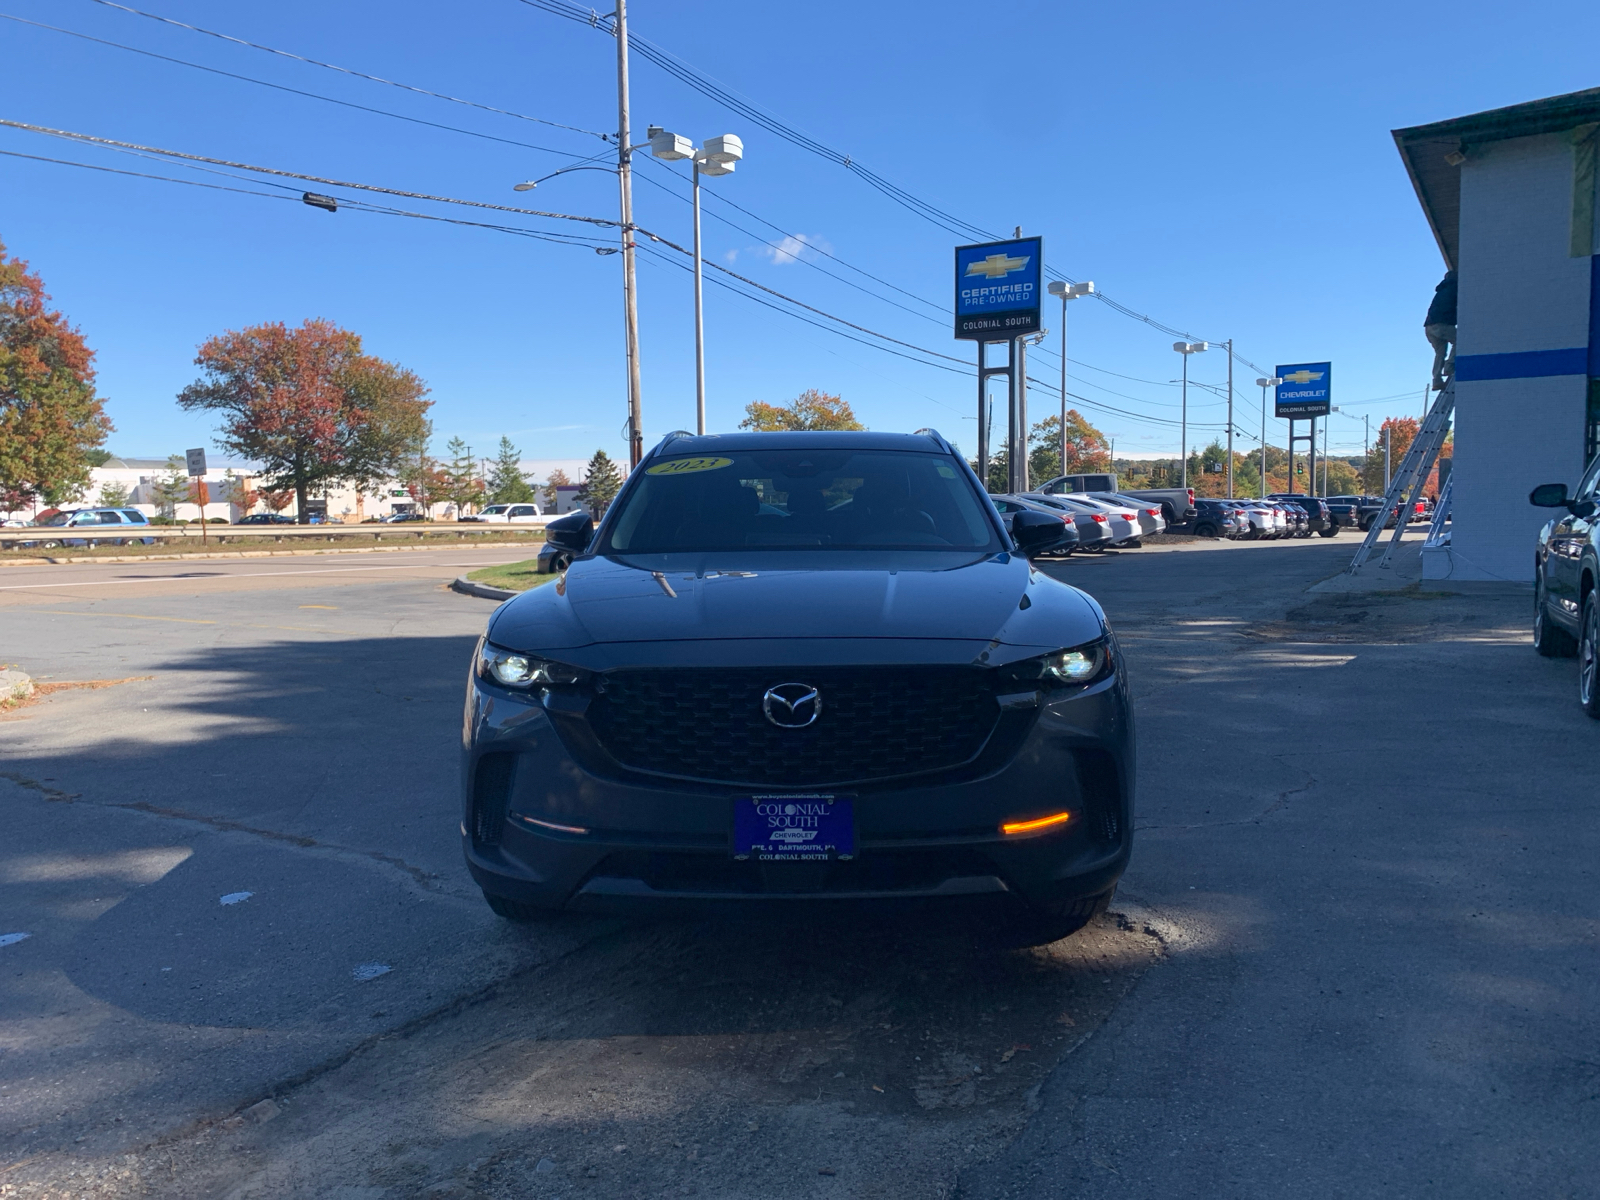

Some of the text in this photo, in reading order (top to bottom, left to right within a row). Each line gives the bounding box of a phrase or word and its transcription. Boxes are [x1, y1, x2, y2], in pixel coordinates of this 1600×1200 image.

[962, 283, 1033, 298] CERTIFIED
[965, 292, 1030, 306] PRE-OWNED
[963, 317, 1031, 330] COLONIAL SOUTH
[1280, 390, 1326, 399] CHEVROLET
[659, 458, 719, 473] 2023
[757, 804, 830, 816] COLONIAL
[768, 816, 818, 827] SOUTH
